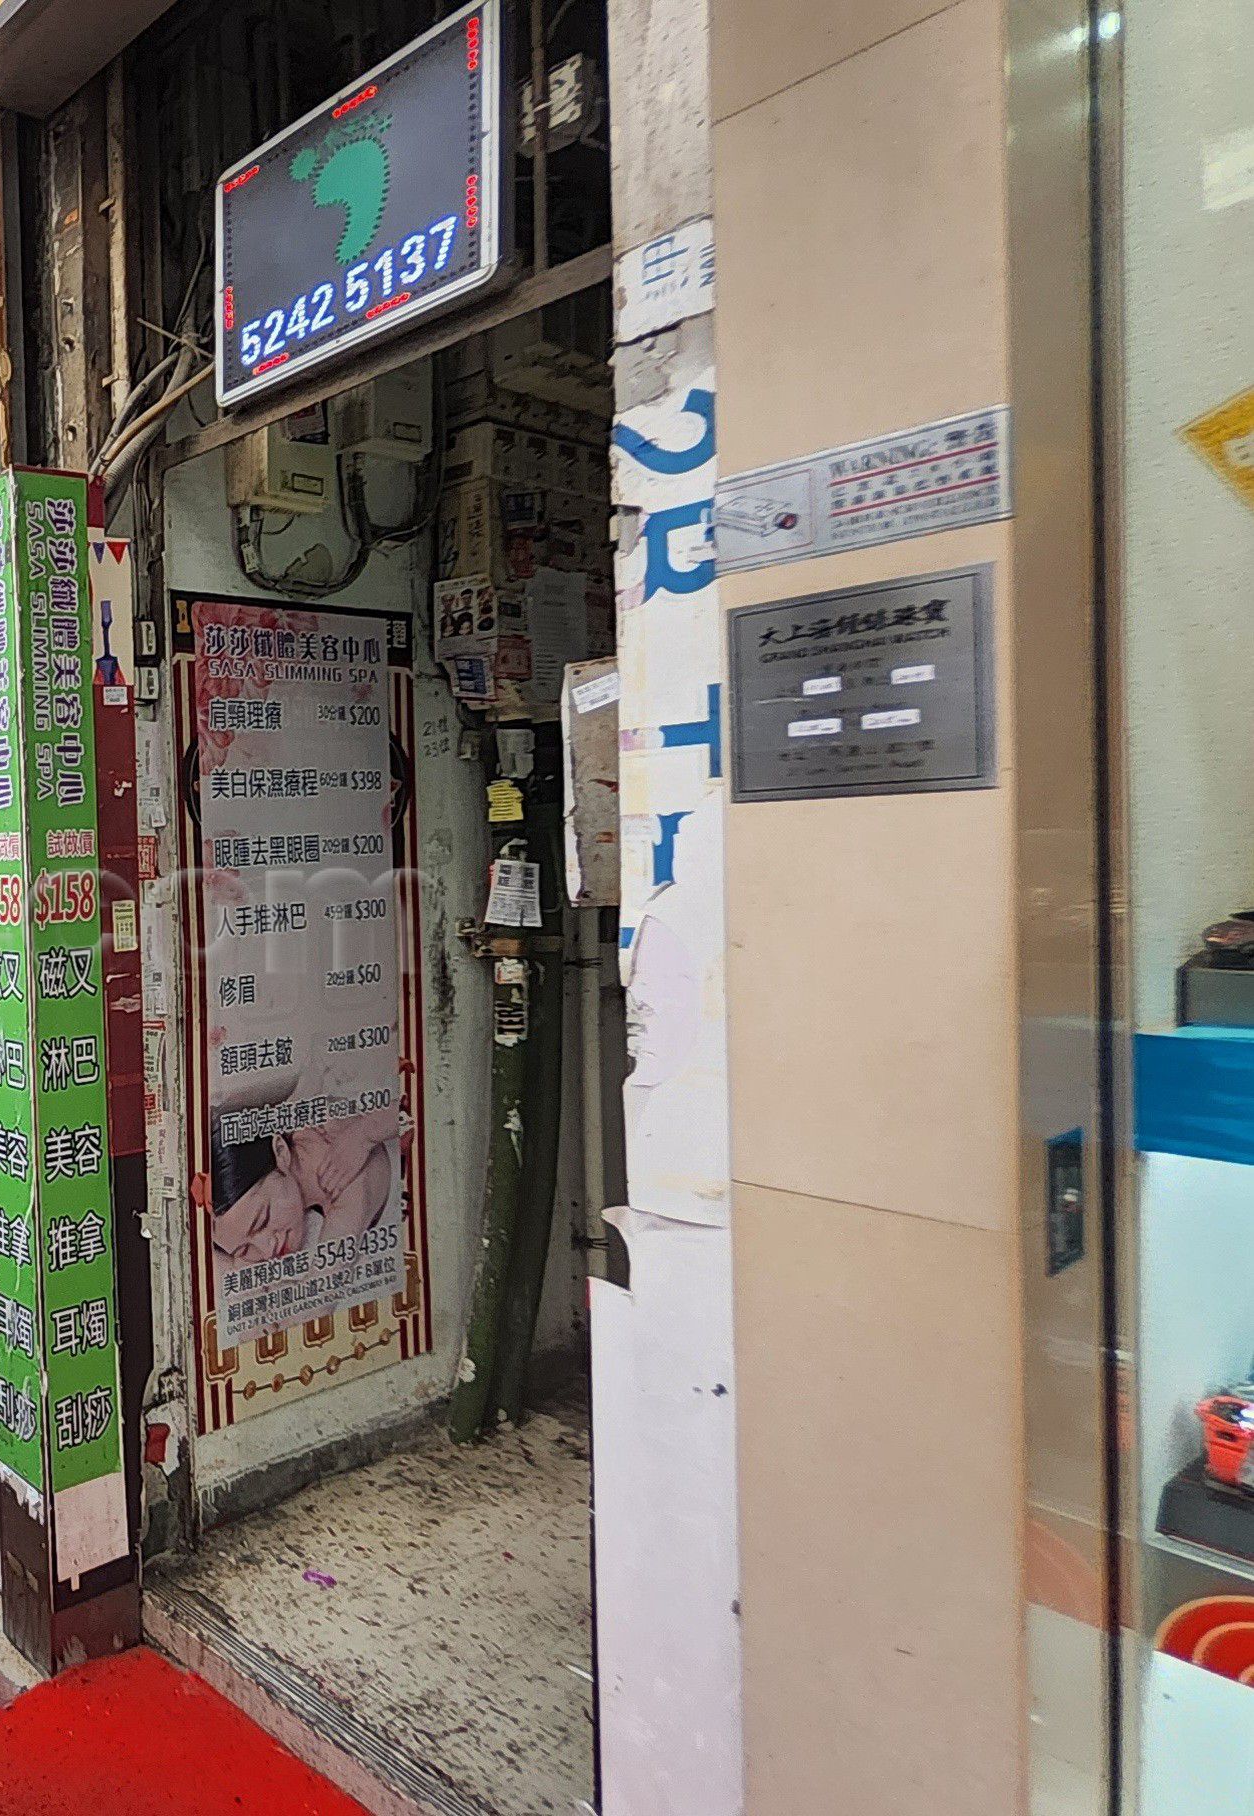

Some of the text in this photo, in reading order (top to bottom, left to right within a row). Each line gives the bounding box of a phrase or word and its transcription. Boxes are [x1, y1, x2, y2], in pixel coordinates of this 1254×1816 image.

[240, 214, 459, 367] 5242 5137
[26, 501, 54, 801] SASA SLIMMING SPA
[45, 497, 86, 808] 莎莎纖體美容中心
[209, 659, 379, 684] SASA SLIMMING SPA
[350, 705, 381, 726] $200
[351, 770, 382, 791] $398
[46, 829, 96, 860] 試做價
[352, 834, 384, 855] $200
[34, 870, 97, 931] $158
[355, 898, 387, 920] $300
[218, 974, 256, 1009] 修眉
[358, 963, 382, 985] $60
[358, 1025, 390, 1049] $300
[39, 1036, 101, 1093] 淋巴
[359, 1088, 391, 1113] $300
[45, 1122, 103, 1183] 美容
[47, 1209, 108, 1273] 推拿
[359, 1224, 398, 1256] 4335
[51, 1297, 109, 1356] 耳燭
[54, 1386, 113, 1451] 刮痧
